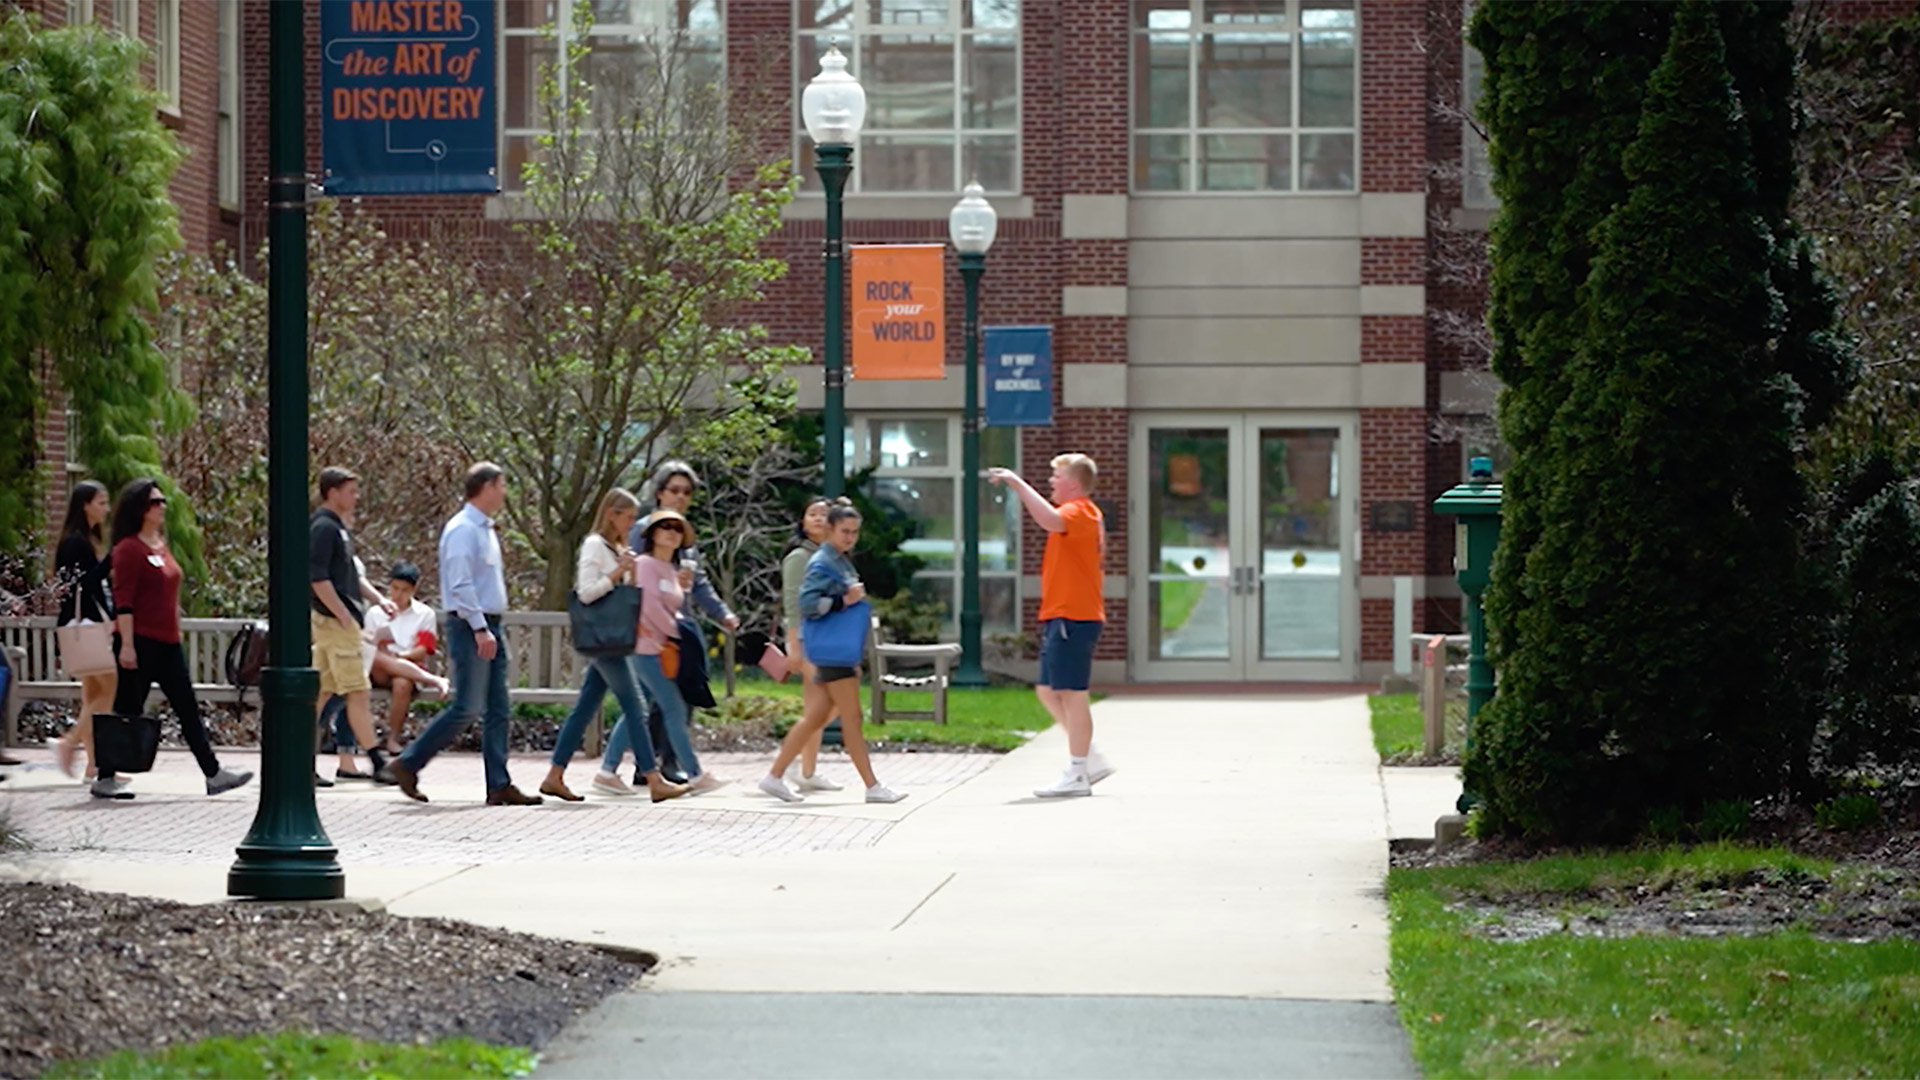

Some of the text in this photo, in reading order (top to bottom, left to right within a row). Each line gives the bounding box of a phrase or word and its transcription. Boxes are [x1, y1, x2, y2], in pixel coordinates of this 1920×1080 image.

[352, 1, 463, 32] MASTER
[343, 44, 481, 82] the ART of
[333, 88, 484, 119] DISCOVERY
[866, 281, 913, 301] ROCK
[885, 304, 922, 319] your
[873, 321, 935, 341] WORLD
[1001, 354, 1036, 367] BY WAY
[995, 379, 1042, 392] BUCKNELL
